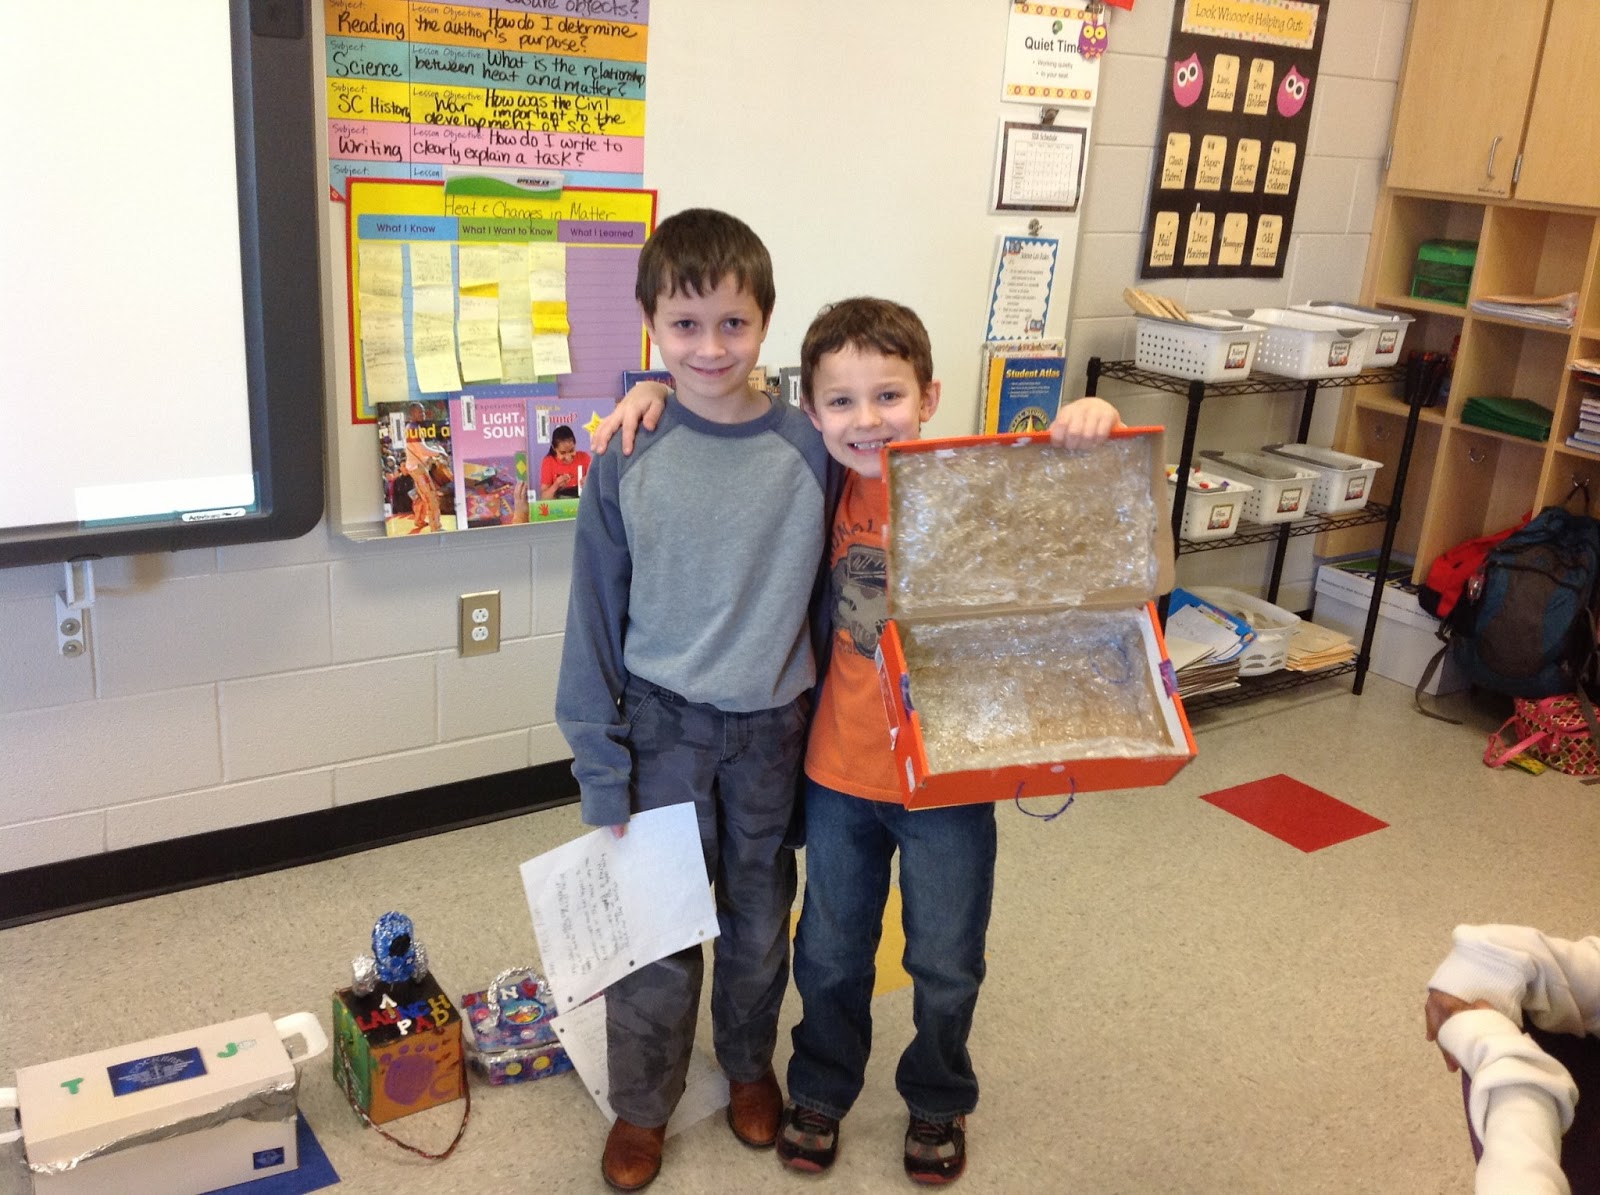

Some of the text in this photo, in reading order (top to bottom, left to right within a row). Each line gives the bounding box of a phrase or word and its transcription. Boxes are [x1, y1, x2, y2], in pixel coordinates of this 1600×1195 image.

[412, 4, 438, 15] Lesson
[566, 0, 639, 19] objects?
[1196, 3, 1216, 19] Look
[1255, 11, 1285, 32] Helping
[338, 12, 405, 40] Reading
[488, 8, 638, 38] How do I determine
[415, 14, 588, 53] the author's purpose?
[413, 45, 484, 62] Lesson Objective:
[1025, 36, 1054, 52] Quiet
[332, 51, 402, 77] Science
[487, 49, 527, 68] What
[534, 55, 547, 72] is
[553, 58, 577, 75] the
[415, 58, 627, 97] between heat and matter?
[413, 87, 439, 99] Lesson
[485, 88, 609, 112] How was the Civil
[338, 95, 411, 123] SC History
[435, 96, 626, 125] War important to the
[424, 113, 532, 131] development
[542, 118, 559, 132] of
[413, 127, 439, 138] Lesson
[489, 129, 623, 153] How do I write to
[339, 136, 402, 162] Writing
[413, 141, 461, 164] clearly
[464, 148, 511, 167] explain
[515, 155, 527, 164] a
[413, 167, 440, 177] Lesson
[444, 194, 477, 219] Heat
[492, 202, 543, 228] Changes
[550, 208, 562, 219] in
[569, 202, 616, 221] Matter
[376, 223, 436, 234] What I Know
[462, 224, 553, 236] What I Want to Know
[570, 228, 634, 238] What I Learned
[1006, 368, 1060, 378] Student Atlas
[482, 412, 519, 424] LIGHT
[483, 426, 524, 439] SOUN
[500, 986, 519, 1000] N
[397, 1009, 450, 1035] PAD
[217, 1042, 238, 1058] J
[61, 1076, 85, 1095] T
